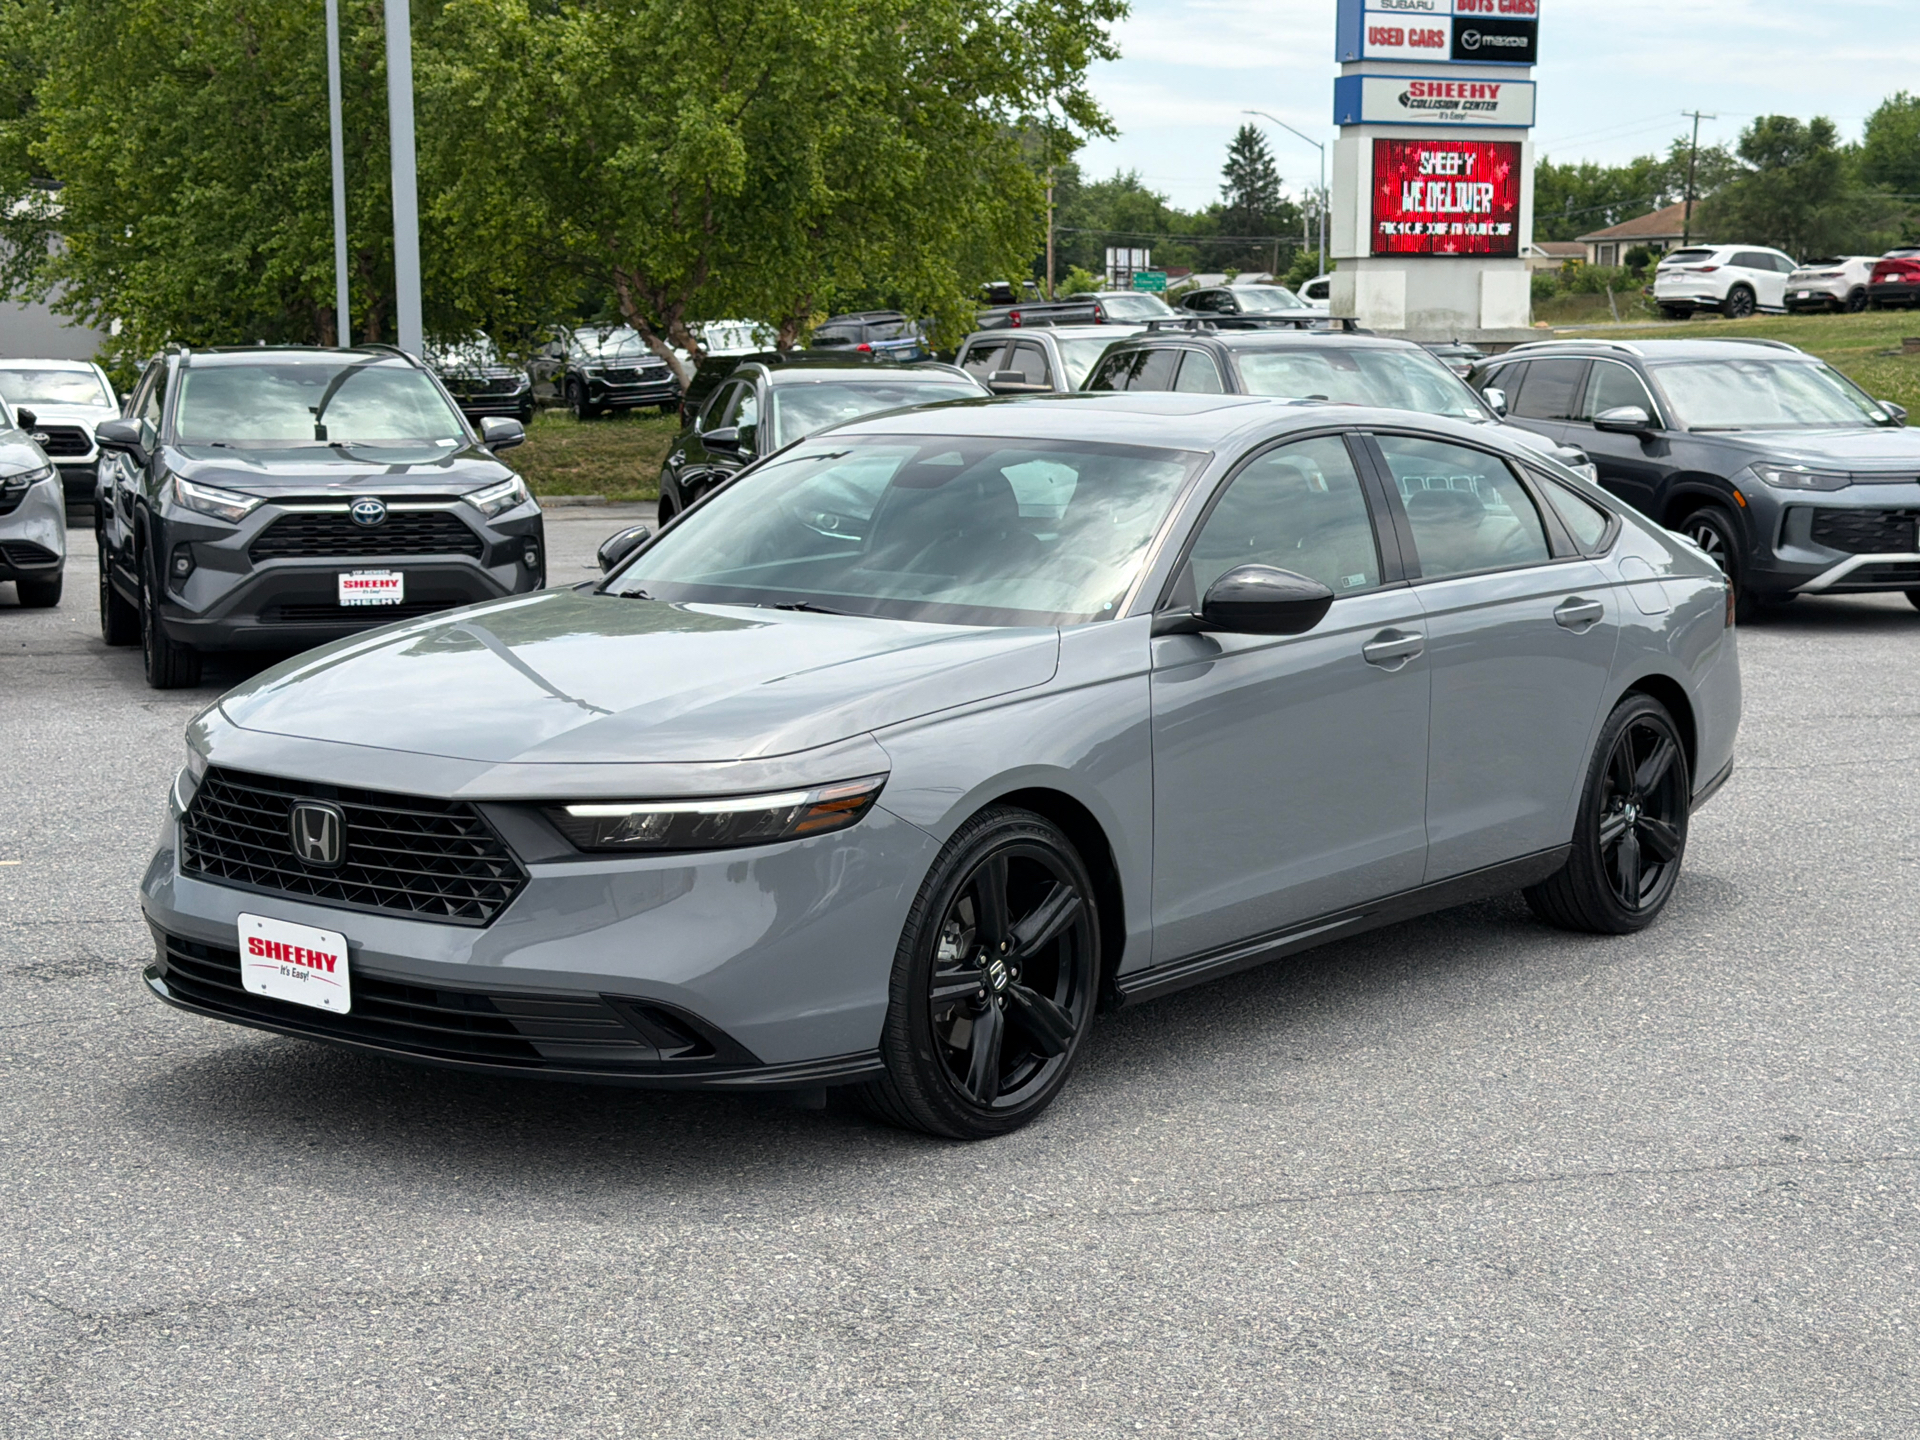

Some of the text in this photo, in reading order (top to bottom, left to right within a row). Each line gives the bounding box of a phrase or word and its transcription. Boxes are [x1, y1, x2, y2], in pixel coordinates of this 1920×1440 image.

[1380, 0, 1434, 10] SUBARU
[1498, 0, 1536, 14] CARS
[1368, 26, 1445, 48] USED CARS
[1409, 81, 1501, 99] SHEEHY
[1409, 98, 1498, 111] COLLISION CENTER
[343, 579, 399, 588] SHEEHY
[247, 936, 338, 974] SHEEHY
[280, 964, 310, 982] It's Easy!
